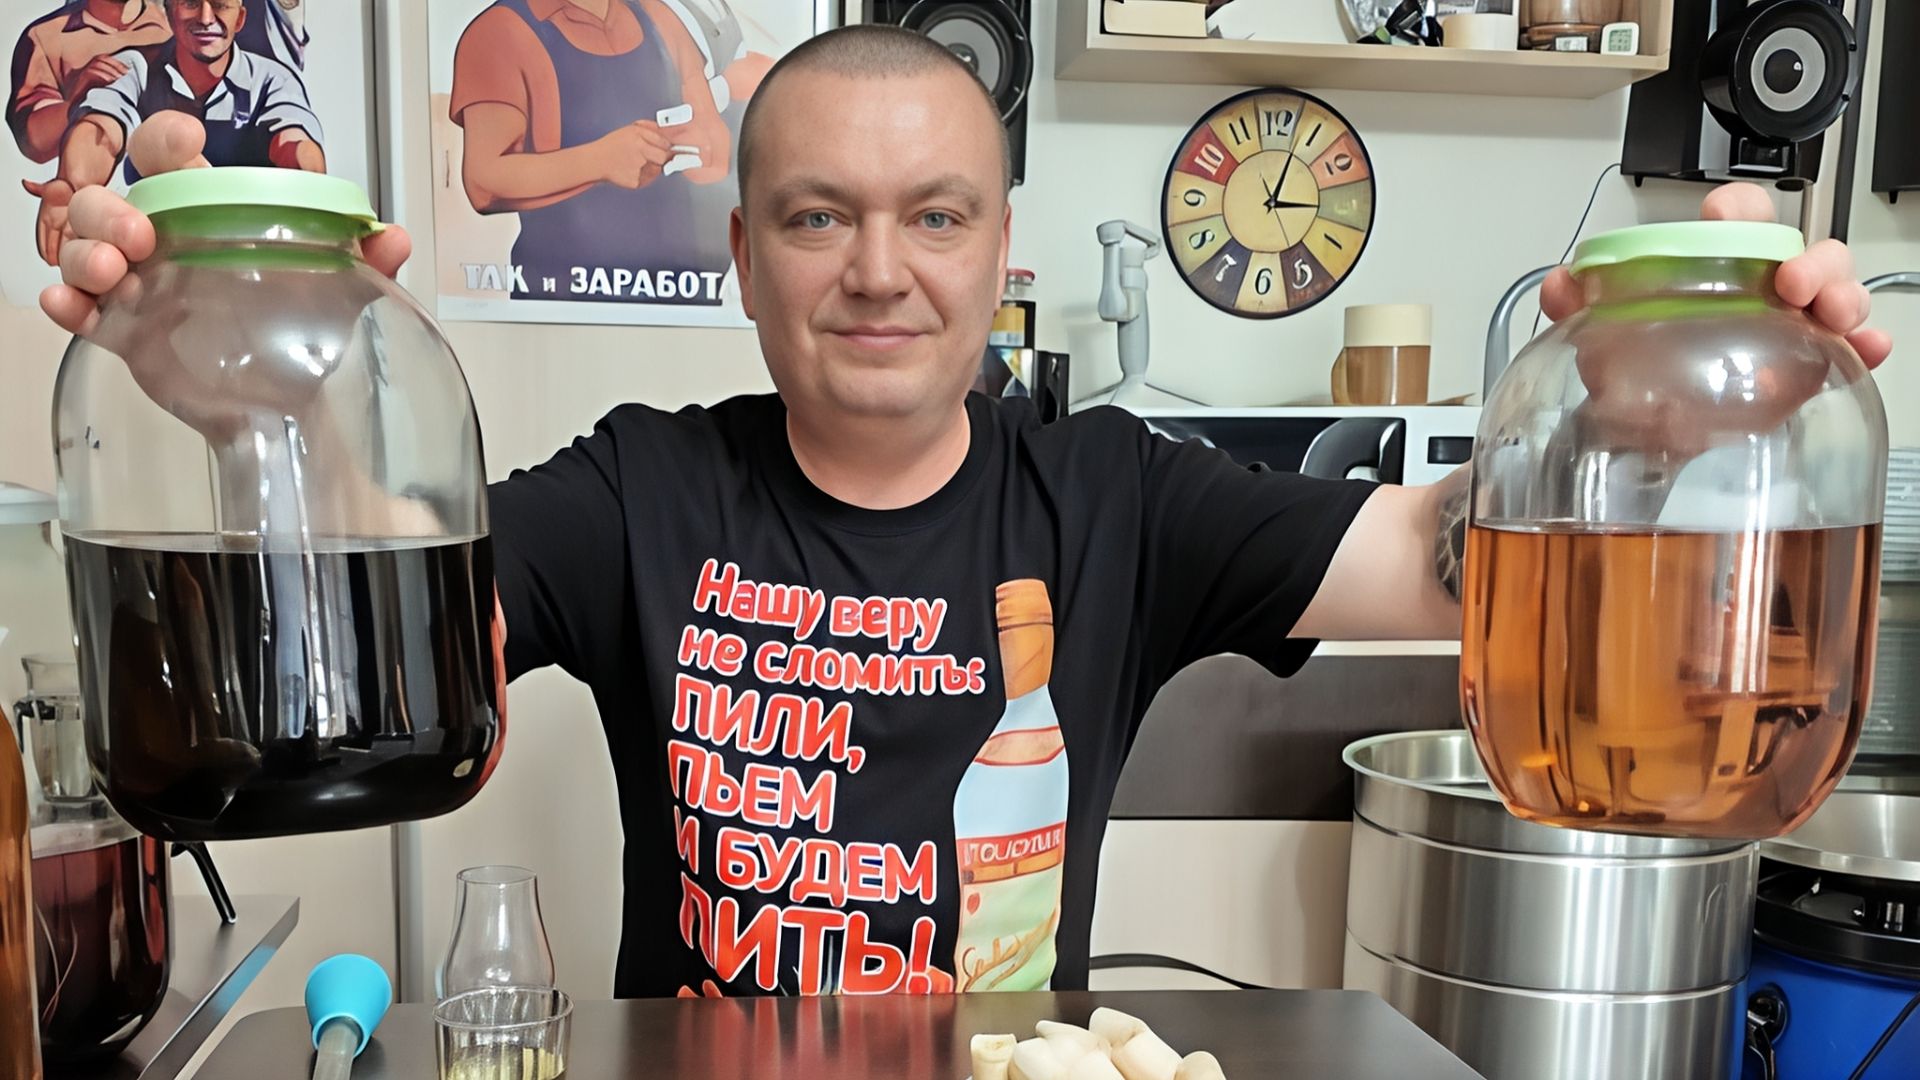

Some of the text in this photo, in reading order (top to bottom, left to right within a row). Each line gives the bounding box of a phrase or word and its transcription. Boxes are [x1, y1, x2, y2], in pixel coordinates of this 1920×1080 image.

[1228, 116, 1252, 146] 11
[1263, 110, 1294, 137] 12
[1193, 143, 1226, 176] 10
[1188, 228, 1215, 250] 8
[1214, 253, 1237, 282] 7
[1255, 267, 1272, 295] 6
[694, 558, 947, 652] Нашу веру
[678, 625, 748, 674] не
[673, 673, 866, 773] ПИЛИ,
[668, 740, 837, 833] ПЬЕМ
[674, 805, 699, 874] И
[716, 826, 937, 908] БУДЕМ
[679, 871, 937, 996] ПИТЬ!
